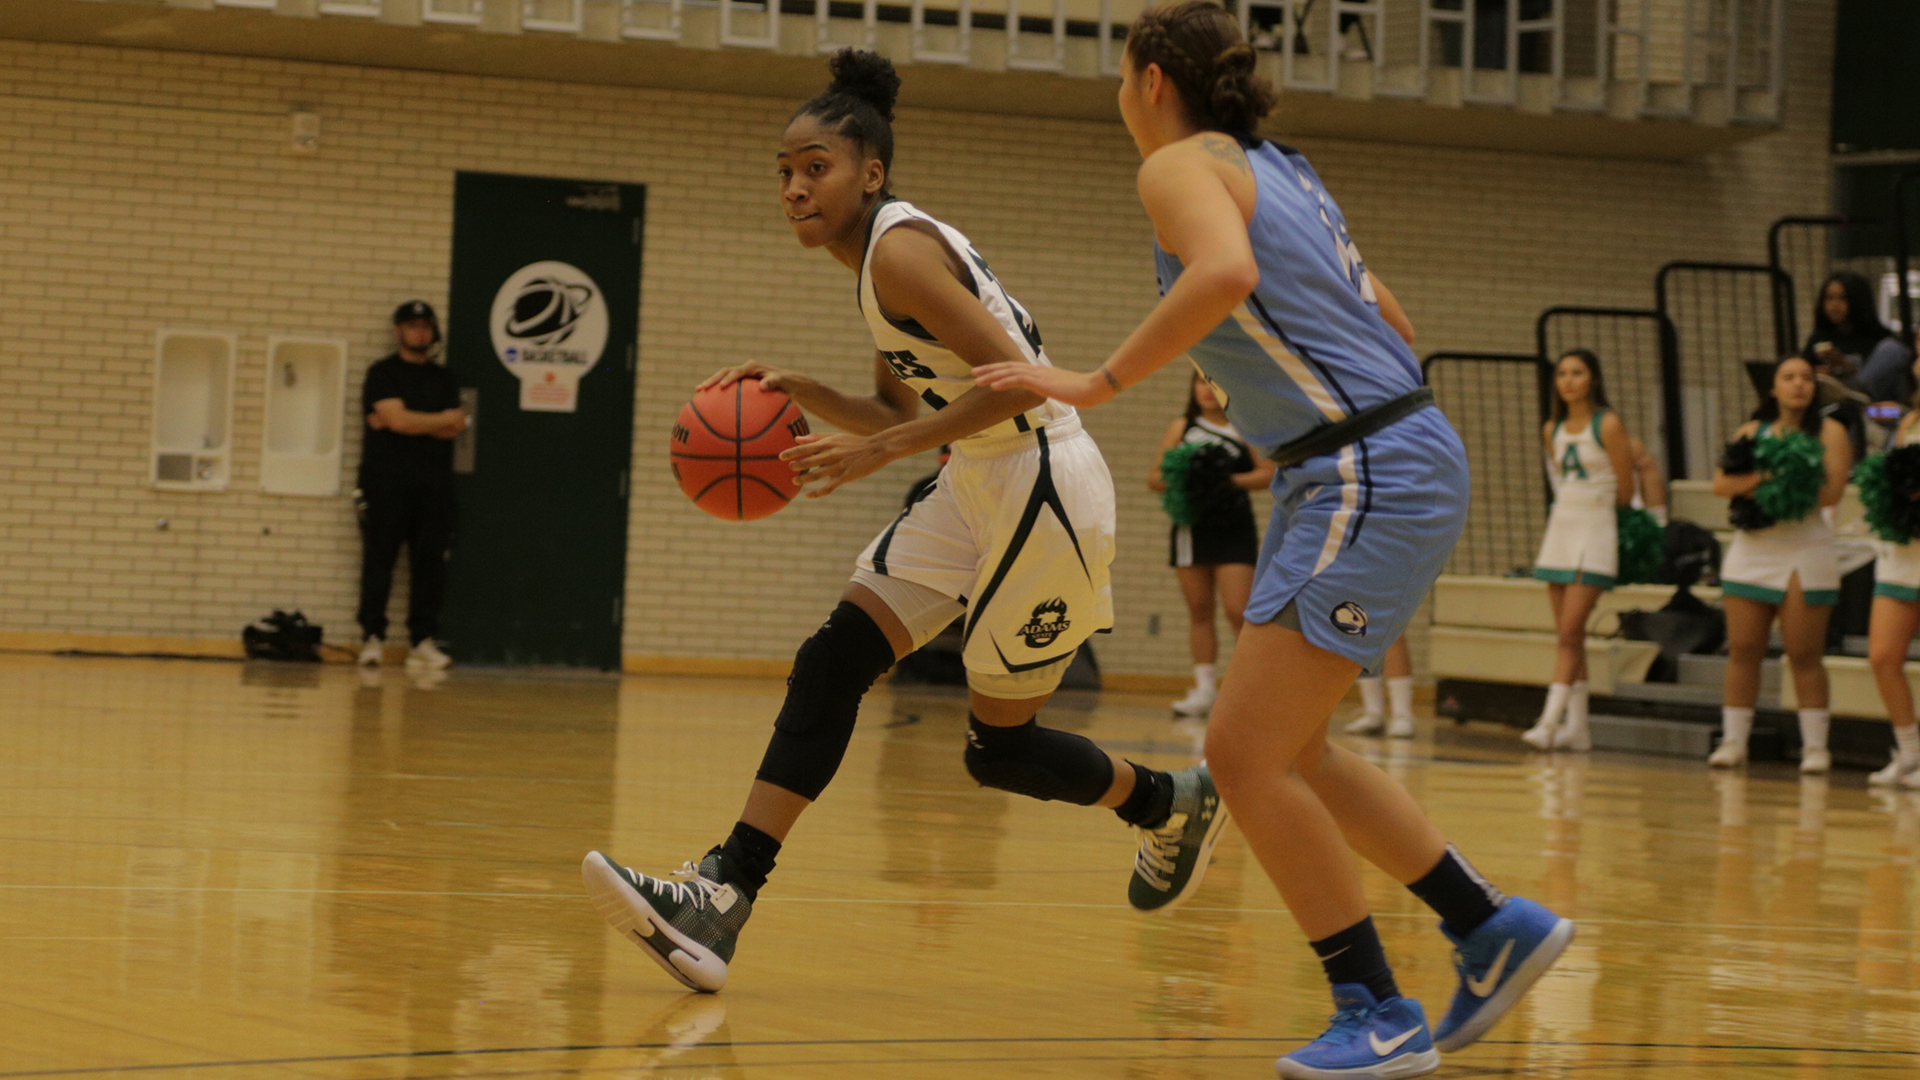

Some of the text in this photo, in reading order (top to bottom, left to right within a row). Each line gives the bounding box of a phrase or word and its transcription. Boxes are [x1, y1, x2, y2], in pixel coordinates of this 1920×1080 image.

[522, 350, 587, 364] BASKETBALL
[881, 349, 937, 379] ES
[1562, 443, 1588, 479] A
[1017, 620, 1070, 635] ADAMS
